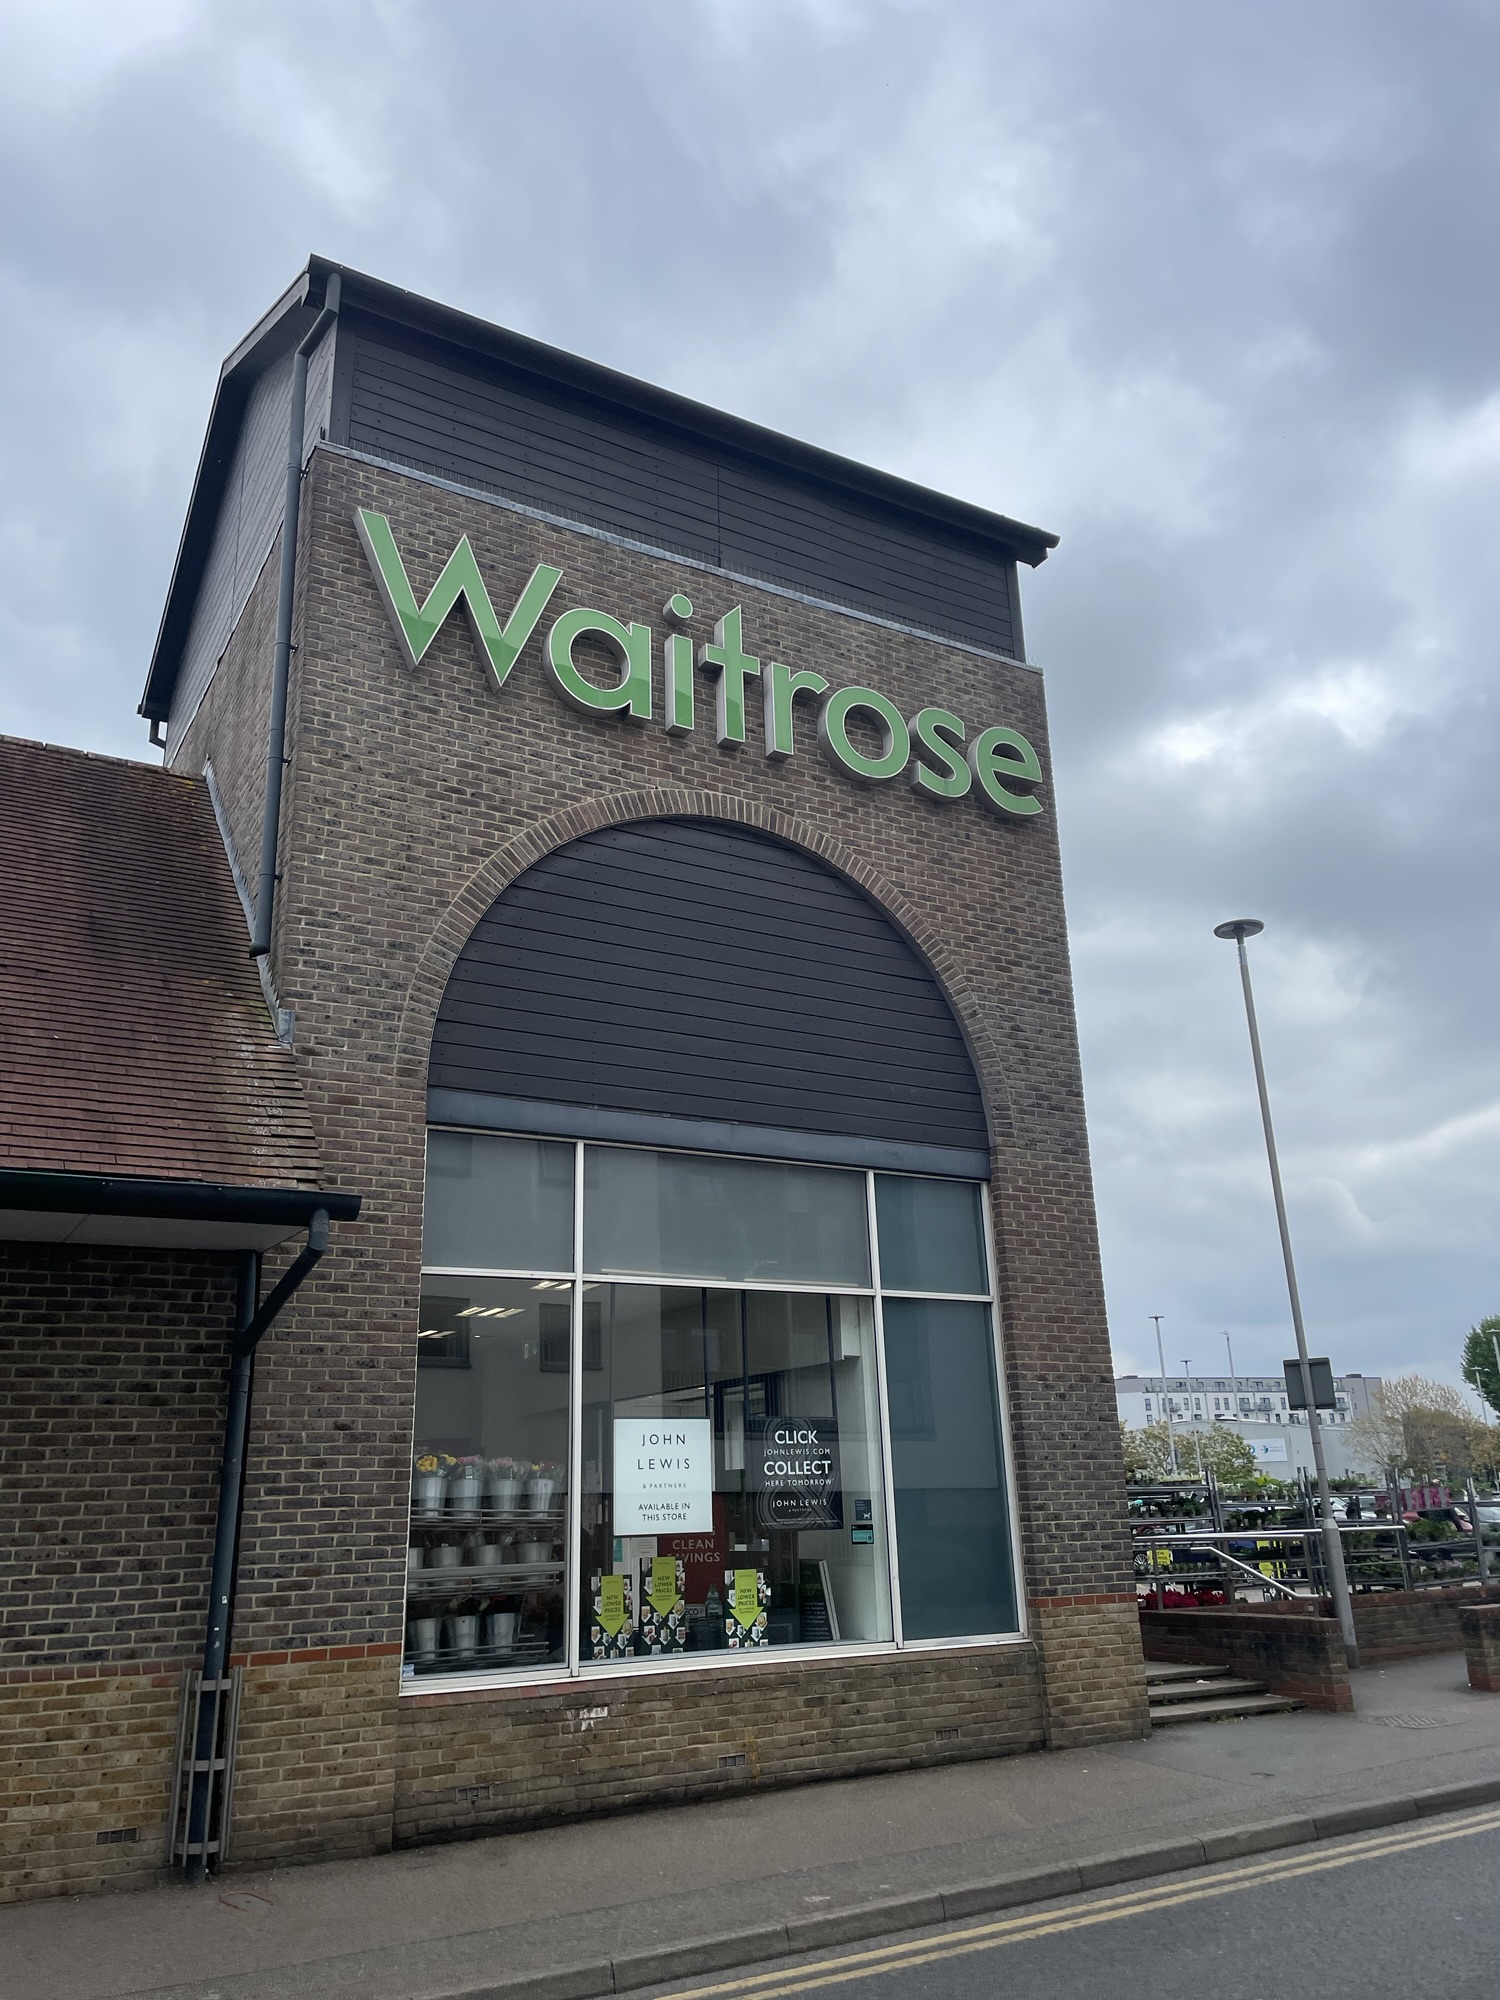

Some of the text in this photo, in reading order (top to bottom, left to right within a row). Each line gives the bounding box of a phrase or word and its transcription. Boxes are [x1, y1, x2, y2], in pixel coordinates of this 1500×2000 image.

[353, 507, 1044, 817] Waitrose
[642, 1434, 686, 1446] JOHN
[775, 1430, 818, 1444] CLICK
[638, 1458, 690, 1470] LEWIS
[764, 1460, 831, 1475] COLLECT
[638, 1503, 679, 1511] AVAILABLE
[773, 1499, 827, 1508] JOHN LEWIS
[672, 1539, 714, 1550] CLEAN
